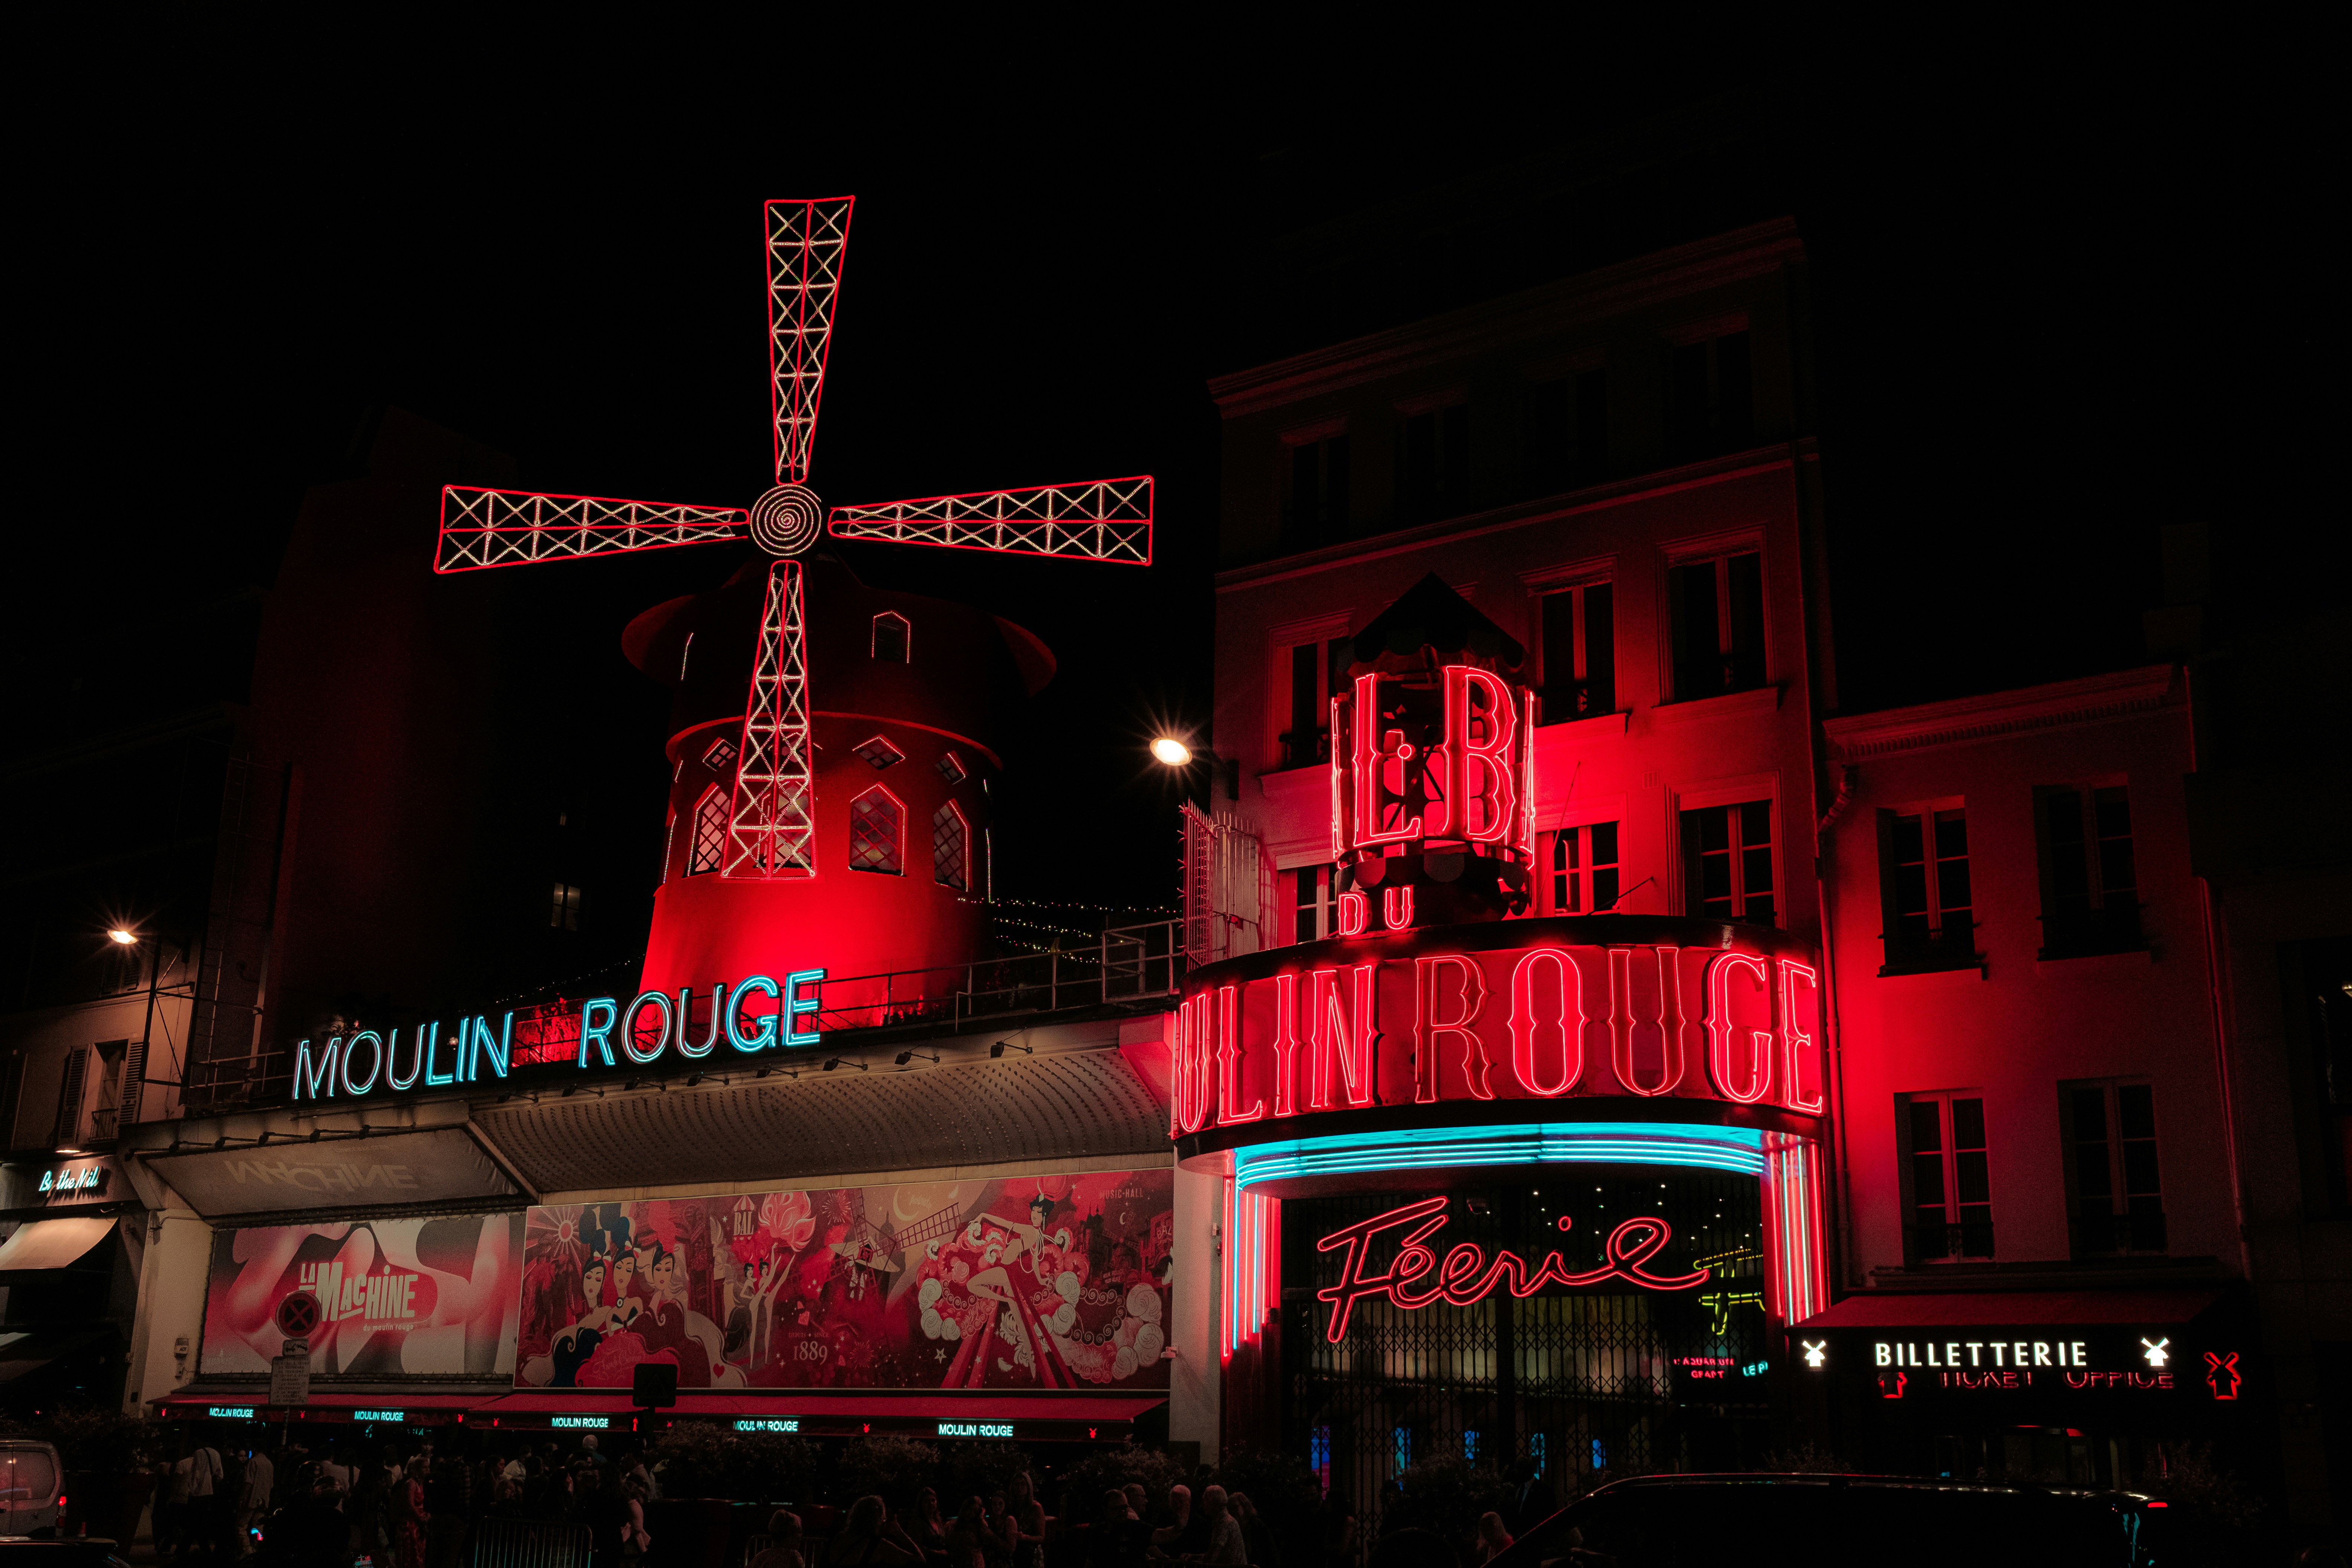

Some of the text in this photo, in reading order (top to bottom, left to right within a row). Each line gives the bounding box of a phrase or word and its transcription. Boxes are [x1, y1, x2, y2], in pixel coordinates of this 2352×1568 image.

[1338, 887, 1414, 936] DU
[292, 968, 828, 1099] MOULIN ROUGE
[1171, 946, 1825, 1136] ULIN ROUGE
[57, 1168, 75, 1190] the
[1100, 1188, 1143, 1199] MUSIC-HALL
[733, 1211, 754, 1236] BAL
[300, 1263, 315, 1283] LA
[1317, 1195, 1709, 1343] Féerie
[395, 1324, 414, 1332] rouge
[793, 1341, 828, 1365] 1889
[1875, 1341, 2087, 1367] BILLETTERIE
[233, 1408, 254, 1418] ROUGE
[354, 1411, 404, 1421] MOULIN ROUGE
[551, 1417, 609, 1428] MOULIN ROUGE
[733, 1420, 799, 1432] MOULIN ROUGE
[938, 1424, 1014, 1437] MOULIN ROUGE
